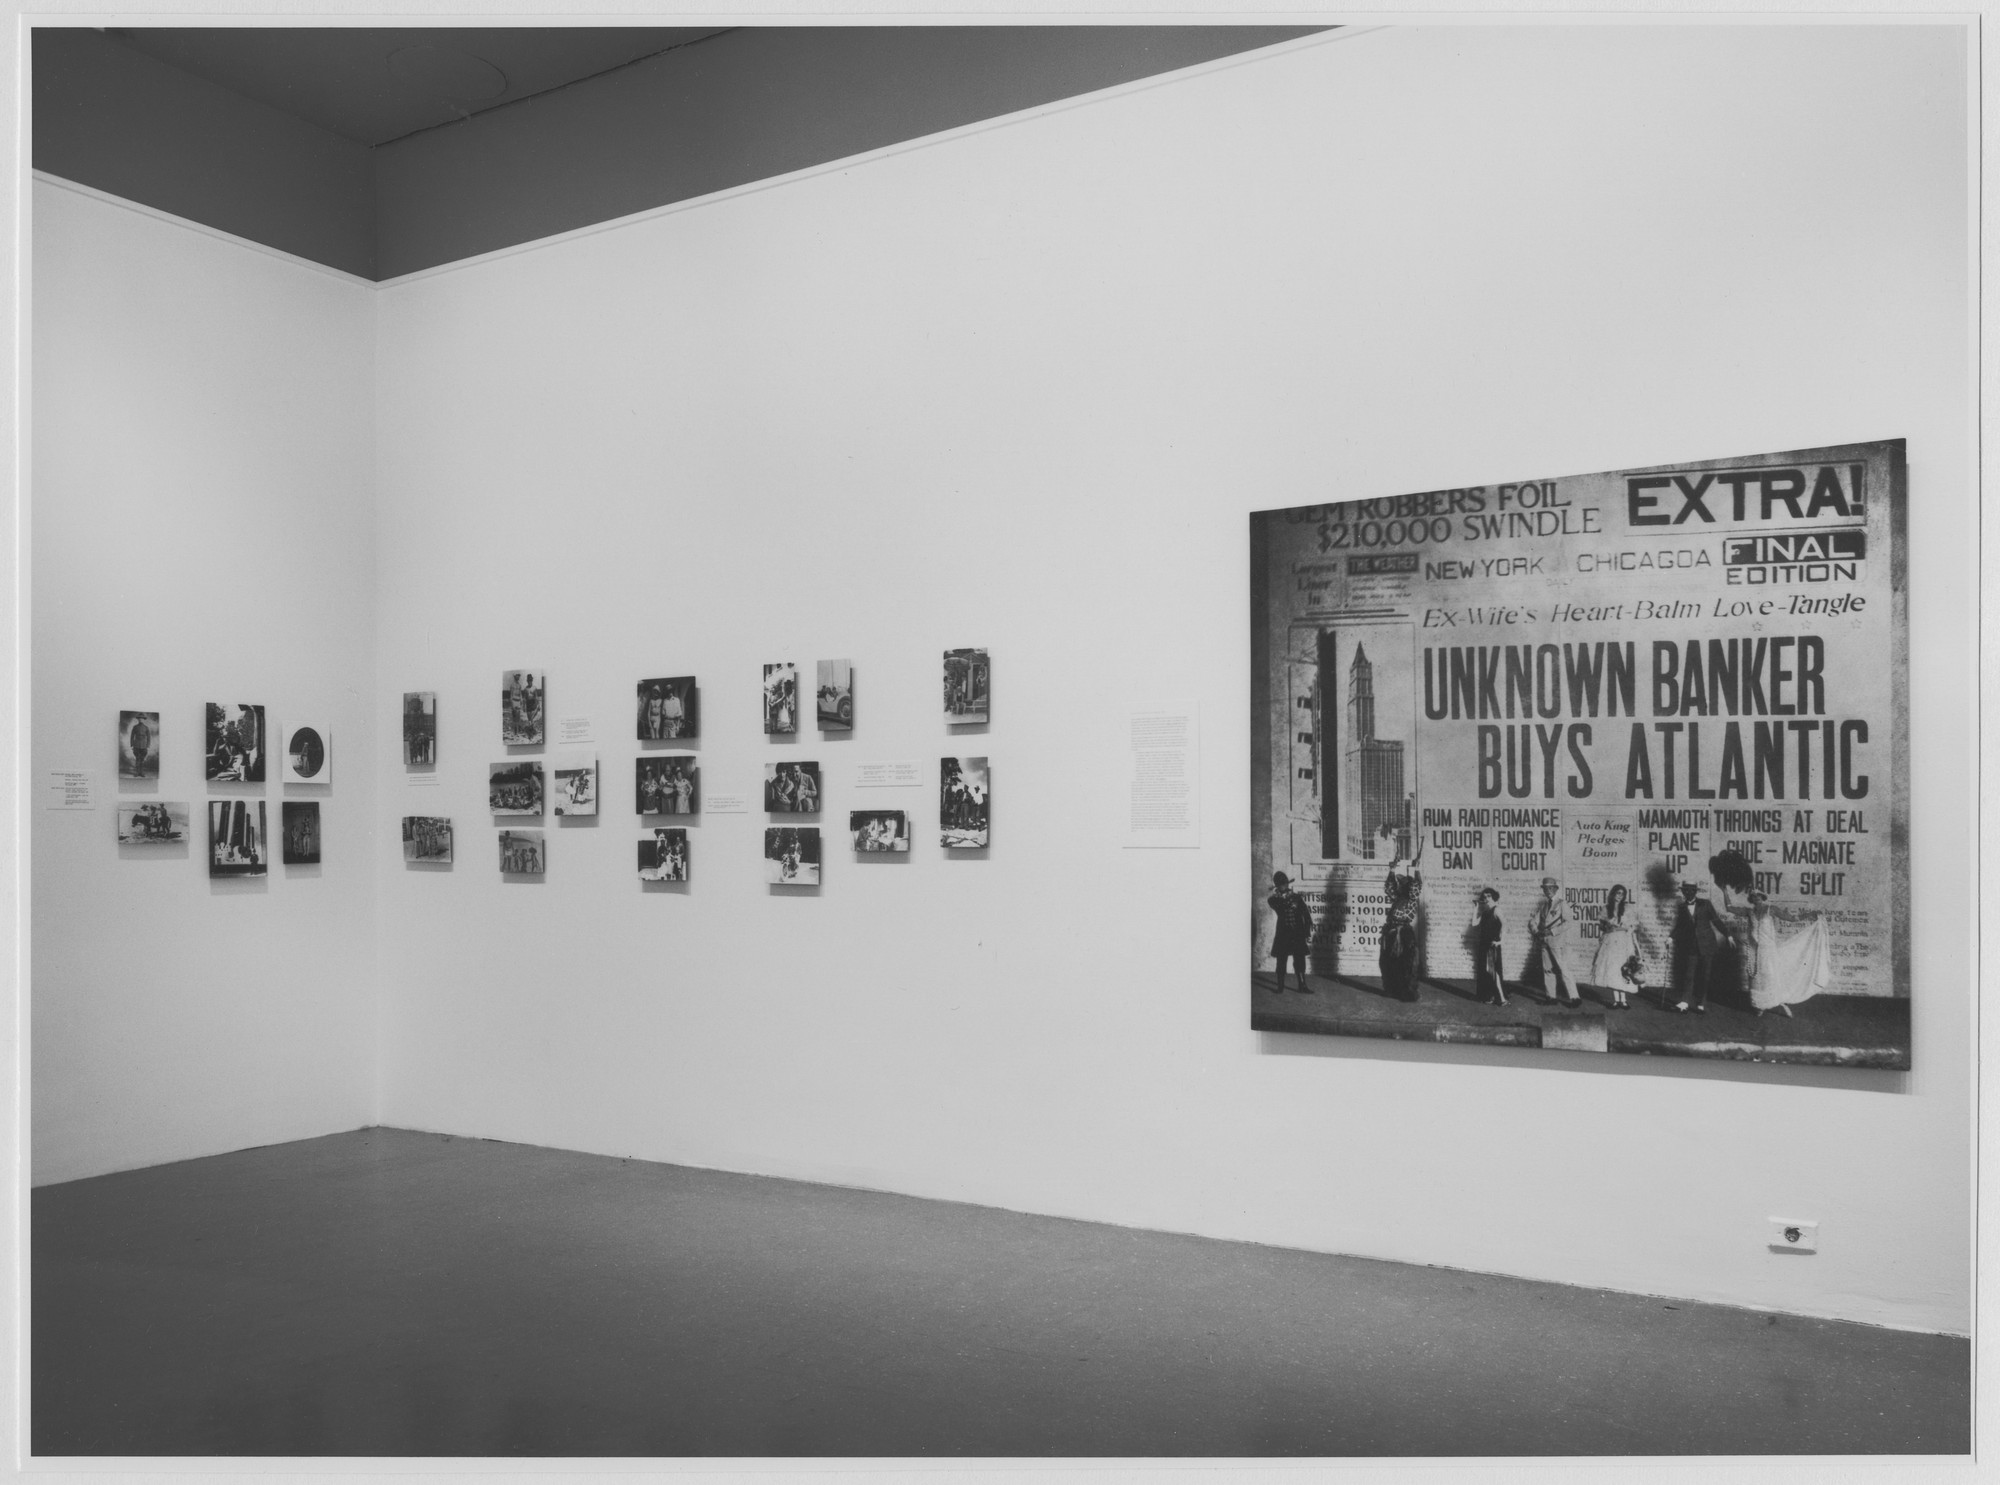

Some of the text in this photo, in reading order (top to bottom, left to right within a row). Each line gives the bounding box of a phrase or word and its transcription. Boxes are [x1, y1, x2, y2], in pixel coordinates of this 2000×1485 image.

[1355, 486, 1487, 520] ROBBERS
[1499, 482, 1572, 510] FOIL
[1627, 464, 1864, 526] EXTRA!
[1317, 508, 1602, 553] $210,000 SWINDLE
[1725, 535, 1856, 564] FINAL
[1425, 556, 1545, 580] NEW YORK
[1727, 562, 1857, 585] EDITION
[1423, 593, 1866, 628] Ex-Wife's Heart-Balm Love-Tangle
[1424, 635, 1826, 720] UNKNOWN BANKER
[1478, 720, 1869, 800] BUYS ATLANTIC
[1423, 808, 1490, 827] RUM RAID
[1493, 808, 1560, 828] ROMANCE
[1572, 820, 1631, 833] Auto King
[1639, 809, 1709, 829] MAMMOTH
[1714, 810, 1869, 833] THRONGS AT DEAL
[1433, 830, 1483, 850] LIQUOR
[1498, 831, 1555, 849] ENDS IN
[1577, 833, 1626, 846] Pledges
[1649, 832, 1700, 851] PLANE
[1443, 851, 1473, 870] BAN
[1501, 852, 1547, 871] COURT
[1582, 847, 1618, 858] Boom
[1782, 841, 1856, 865] MAGNATE
[1666, 854, 1688, 873] UP
[1800, 872, 1846, 896] SPLIT
